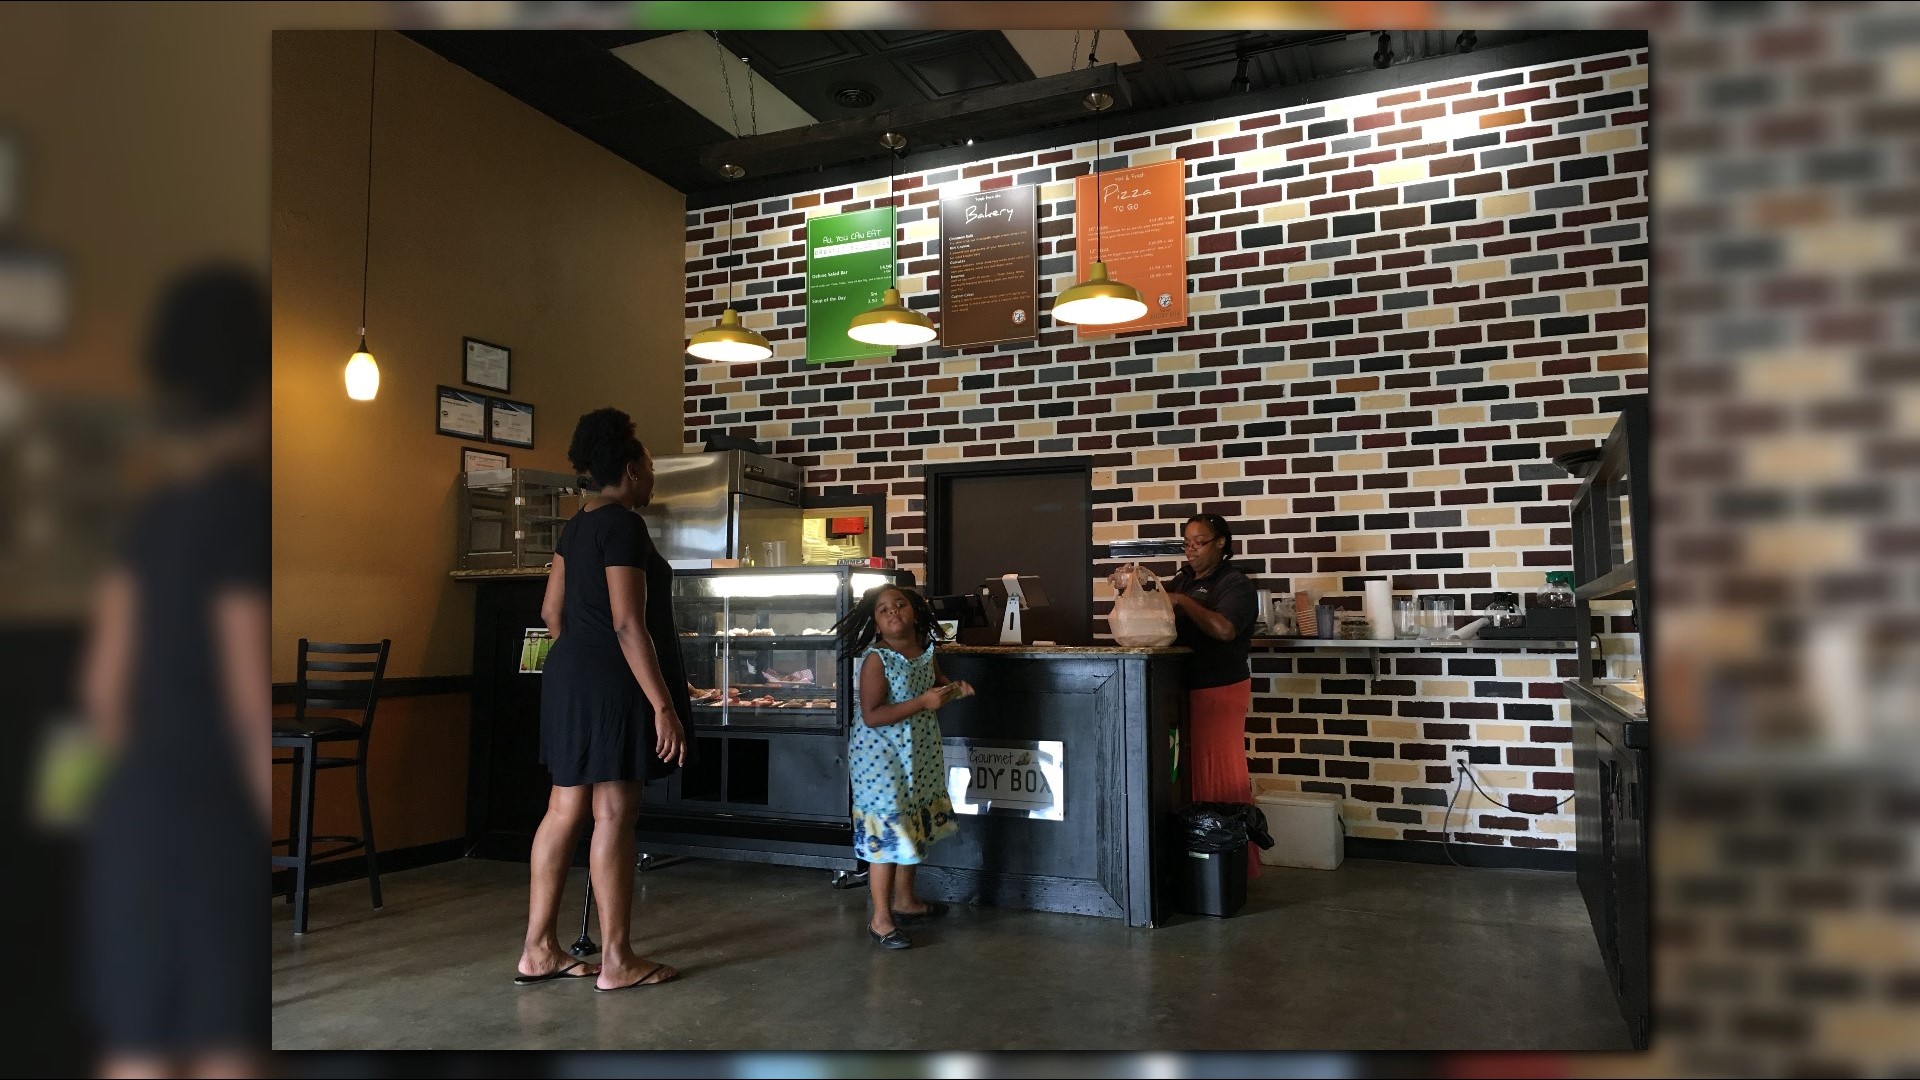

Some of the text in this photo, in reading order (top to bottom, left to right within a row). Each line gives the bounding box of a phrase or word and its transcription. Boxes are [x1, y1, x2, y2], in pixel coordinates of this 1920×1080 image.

[1103, 183, 1152, 203] Pizza
[965, 202, 1014, 225] Bakery
[1127, 203, 1139, 211] GO
[866, 229, 882, 238] EAT
[969, 749, 1014, 765] Gourmet
